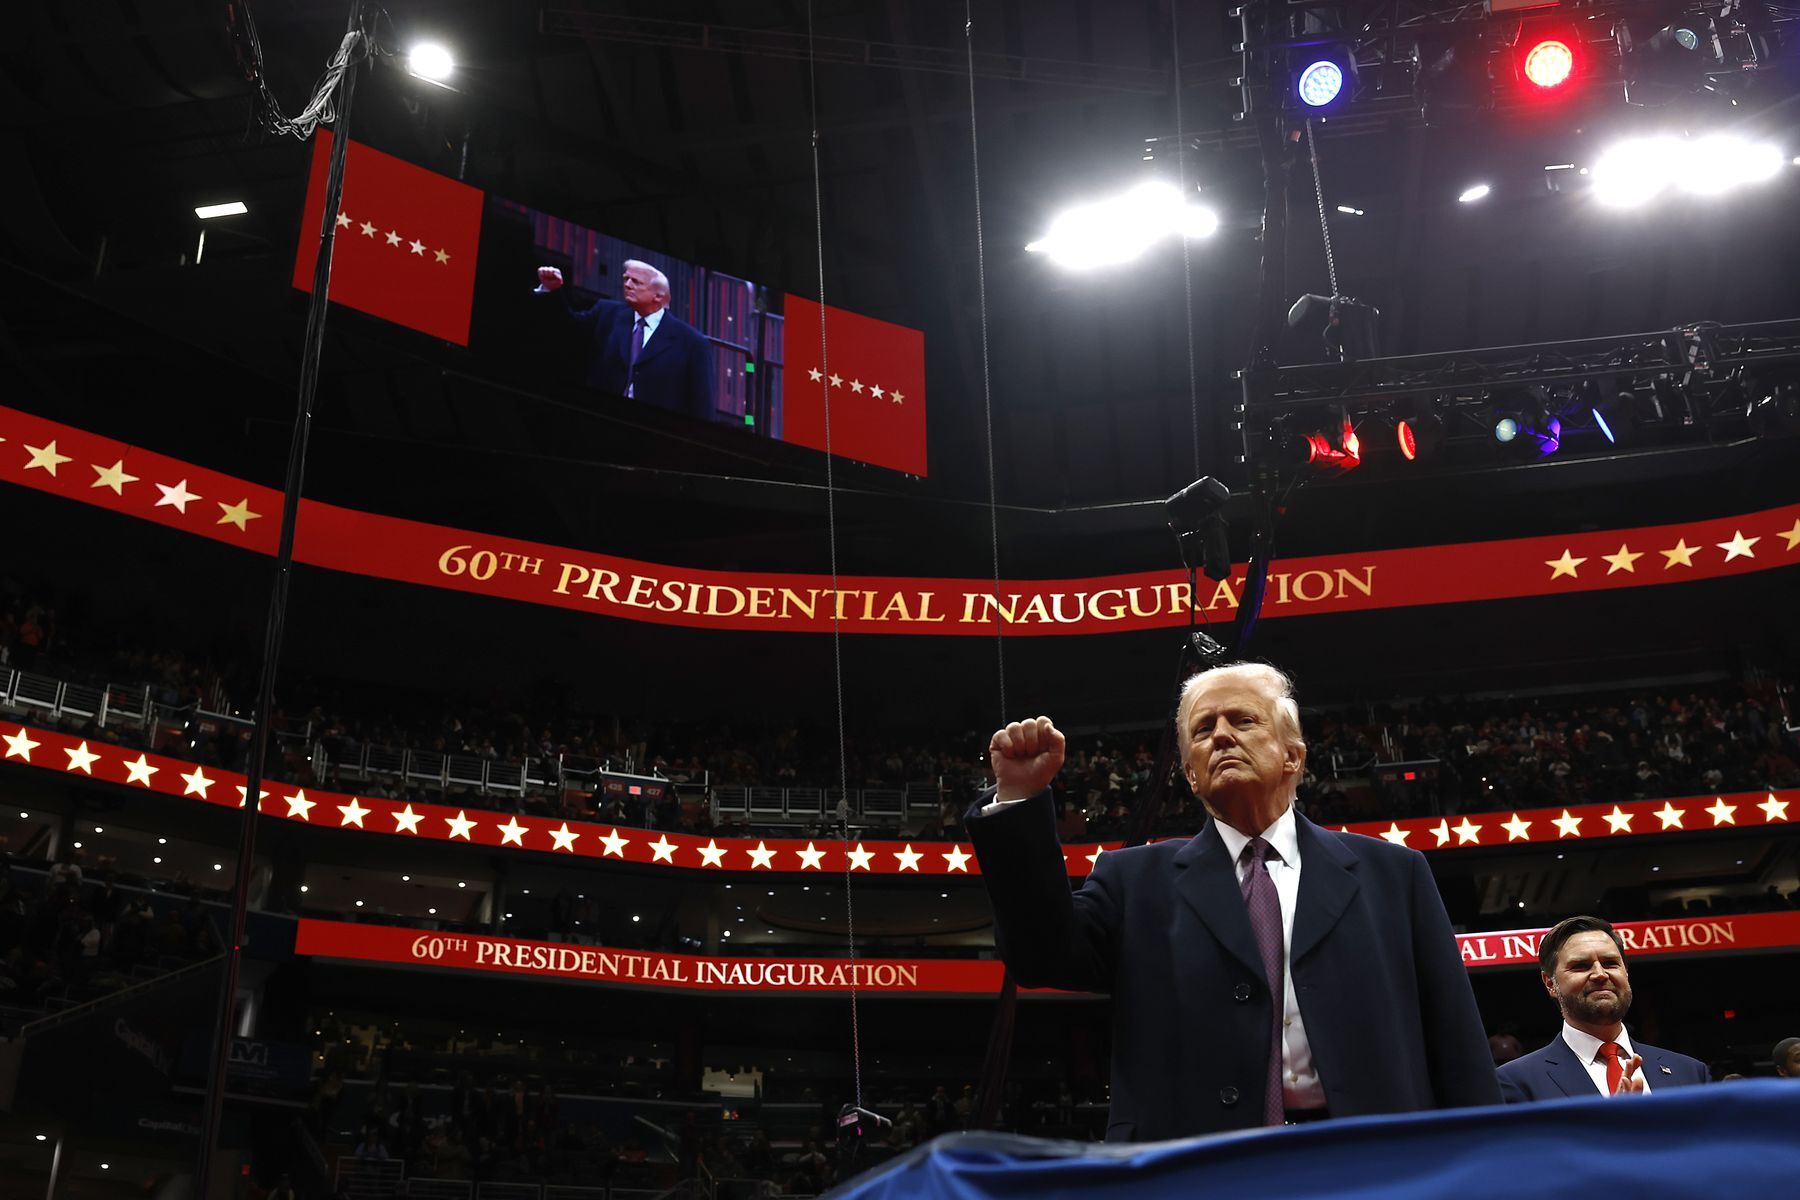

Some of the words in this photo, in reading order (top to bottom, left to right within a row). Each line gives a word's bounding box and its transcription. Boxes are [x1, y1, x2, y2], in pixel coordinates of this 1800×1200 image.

[437, 544, 544, 581] 60TH
[552, 563, 945, 622] PRESIDENTIAL
[958, 566, 1377, 624] INAUGURAION
[411, 935, 468, 960] 60TH
[475, 941, 688, 982] PRESIDENTIAL
[695, 961, 918, 987] INAUGURATION
